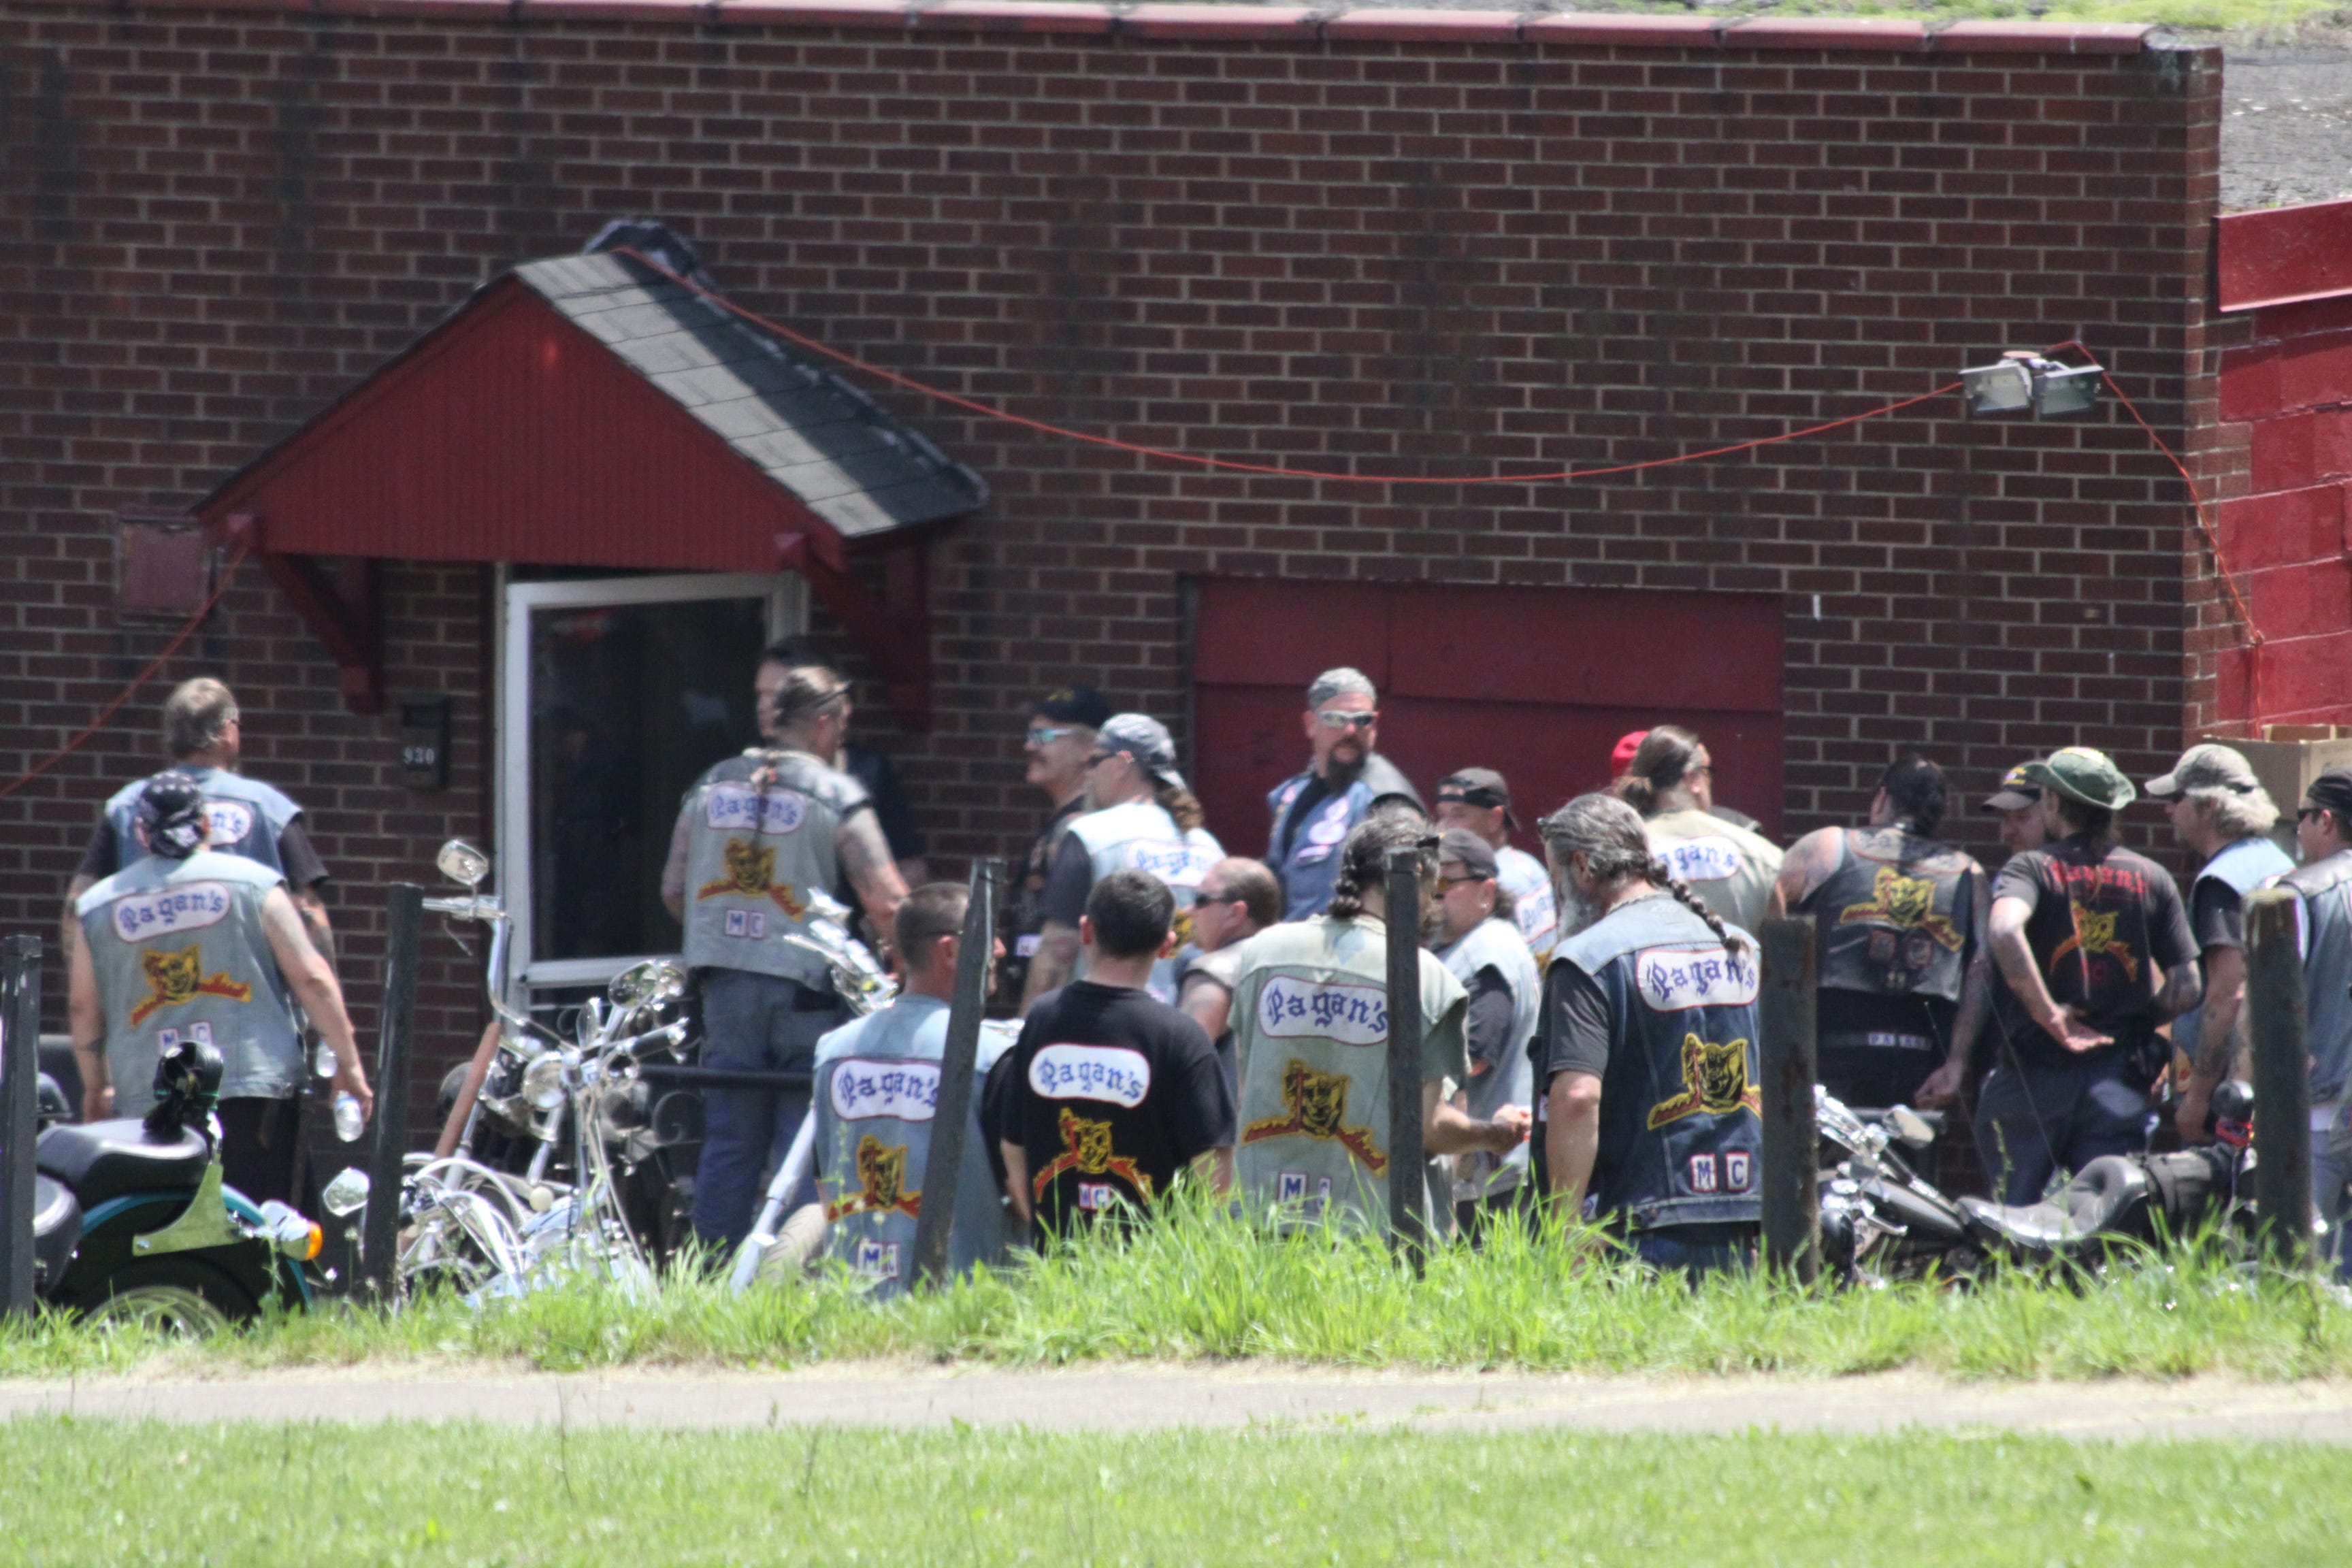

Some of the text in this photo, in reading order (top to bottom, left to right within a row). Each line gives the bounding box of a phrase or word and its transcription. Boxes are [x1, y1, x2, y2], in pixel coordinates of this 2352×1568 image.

[1646, 959, 1754, 1003] Pagan's
[1267, 985, 1388, 1034] Pagan's
[1038, 1057, 1143, 1098] Pagan's
